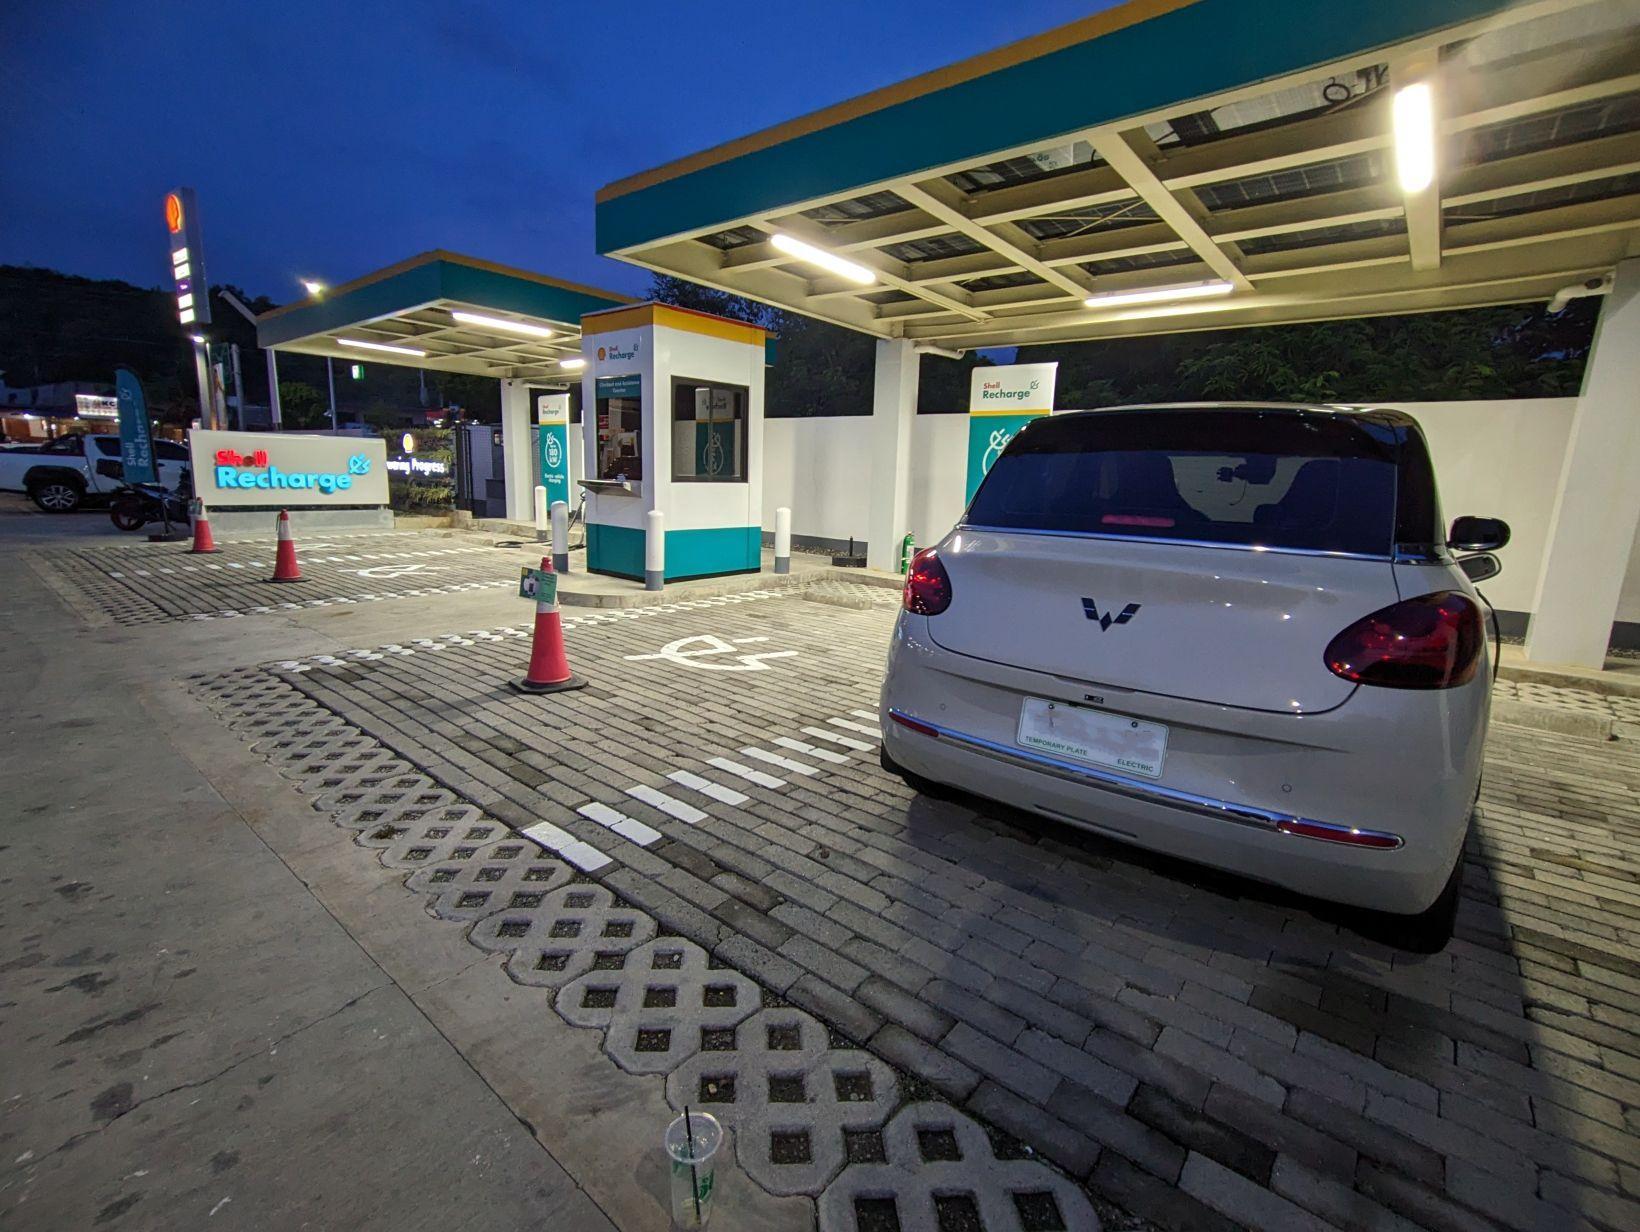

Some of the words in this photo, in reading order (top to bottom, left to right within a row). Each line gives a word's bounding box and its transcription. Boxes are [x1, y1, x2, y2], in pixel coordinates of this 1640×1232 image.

[609, 351, 635, 360] Recharge
[982, 388, 1031, 400] Recharge
[983, 381, 1001, 390] Shell
[124, 442, 136, 466] Shell
[215, 449, 269, 467] Shell
[411, 457, 446, 476] Progress
[215, 465, 353, 494] Recharge
[1025, 735, 1066, 751] TEMPORARY
[1066, 745, 1088, 756] PLATE
[1117, 758, 1154, 772] ELECTRIC
